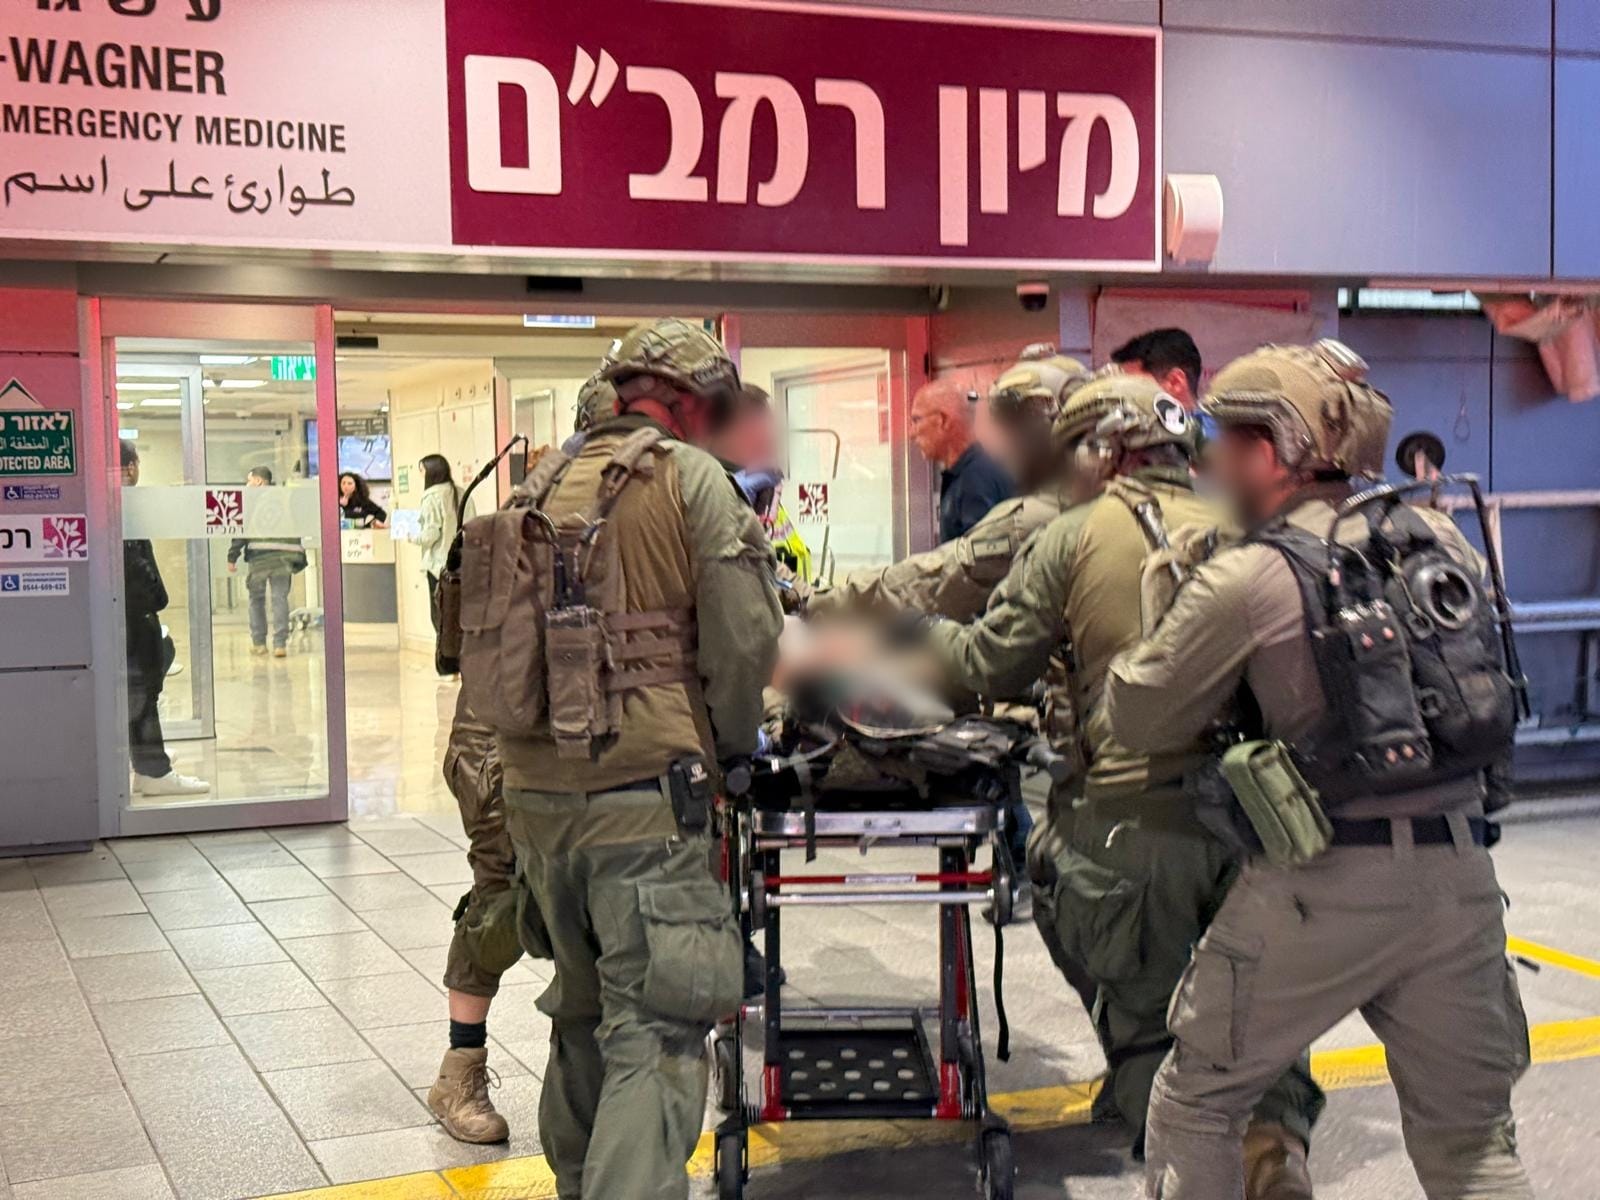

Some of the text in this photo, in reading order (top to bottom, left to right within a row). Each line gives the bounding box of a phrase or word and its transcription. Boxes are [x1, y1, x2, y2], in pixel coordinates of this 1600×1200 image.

[0, 104, 346, 153] MERGENCY MEDICINE
[4, 155, 355, 216] طوارئ على اسم
[938, 84, 1140, 246] מיון
[11, 412, 69, 431] לאזור
[43, 455, 71, 470] AREA
